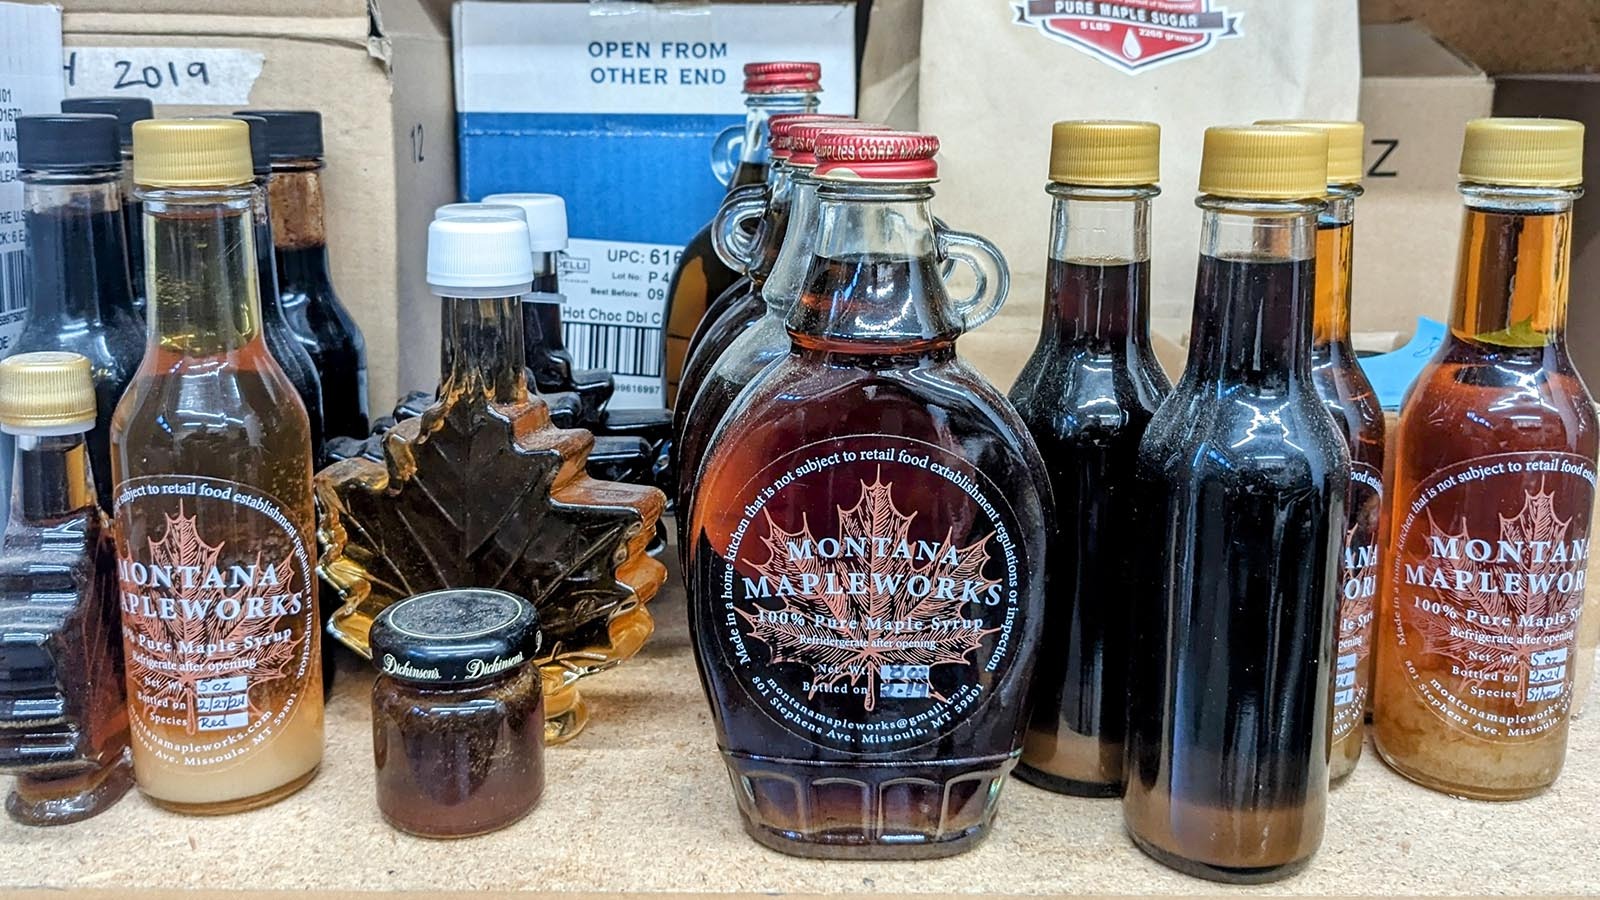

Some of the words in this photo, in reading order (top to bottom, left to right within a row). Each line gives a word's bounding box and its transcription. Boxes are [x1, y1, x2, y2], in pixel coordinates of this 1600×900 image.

[1055, 1, 1094, 14] PURE
[1100, 3, 1146, 22] MAPLE
[1151, 11, 1198, 28] SUGAR
[1090, 22, 1111, 32] LBS
[1165, 32, 1195, 43] grams
[588, 42, 650, 58] OPEN
[662, 43, 727, 58] FROM
[114, 60, 209, 90] 2019
[590, 68, 667, 84] OTHER
[679, 69, 726, 84] END
[410, 123, 425, 163] 12
[1367, 139, 1399, 177] Z
[608, 248, 645, 264] UPC:
[612, 272, 628, 281] Lot
[649, 272, 657, 284] P
[562, 308, 585, 320] Hot
[589, 309, 622, 322] Choc
[626, 311, 648, 323] Dbl
[843, 451, 857, 462] to
[861, 448, 895, 461] retail
[897, 450, 930, 469] food
[796, 453, 840, 477] subject
[774, 471, 796, 491] not
[1411, 493, 1429, 514] that
[1425, 488, 1438, 499] is
[1436, 475, 1458, 492] not
[1457, 462, 1505, 481] subject
[1508, 461, 1522, 472] to
[1525, 458, 1559, 471] retail
[1560, 459, 1584, 475] food
[762, 486, 776, 499] is
[930, 462, 1000, 523] extablishment
[119, 486, 147, 505] subject
[148, 483, 160, 495] to
[161, 482, 196, 495] retail
[199, 483, 232, 500] food
[233, 493, 298, 539] establishment
[745, 495, 767, 519] that
[724, 518, 751, 562] kitchen
[787, 537, 959, 566] MONTANA
[994, 521, 1019, 588] regulations
[721, 563, 734, 600] home
[742, 572, 1003, 607] MAPLEWORKS
[725, 602, 734, 610] a
[1008, 590, 1018, 604] or
[725, 612, 737, 626] in
[758, 610, 805, 626] 100%
[814, 614, 858, 629] Pure
[866, 615, 923, 634] Maple
[931, 617, 984, 634] Syrup
[1414, 595, 1457, 620] 100%
[1465, 609, 1511, 626] Pure
[1518, 612, 1566, 630] Maple
[139, 633, 173, 653] Pure
[178, 640, 239, 657] Maple
[244, 628, 293, 651] Syrup
[870, 638, 894, 648] after
[985, 608, 1019, 673] inspection.
[1450, 625, 1515, 645] Refrigerate
[1516, 633, 1542, 645] after
[1543, 629, 1574, 646] opening
[729, 628, 752, 665] Made
[179, 660, 205, 672] after
[208, 656, 258, 675] opening
[382, 653, 442, 680] Dickinson's
[1468, 650, 1495, 662] Net.
[1500, 654, 1521, 665] Wt.
[848, 664, 870, 676] Wt.
[1452, 665, 1498, 680] Bottled
[1503, 674, 1518, 682] on
[802, 681, 848, 694] Bottled
[853, 686, 868, 695] on
[1405, 660, 1420, 680] 801
[1418, 683, 1469, 725] Stephens
[1472, 722, 1502, 736] Ave.
[1470, 685, 1517, 699] Species
[172, 702, 187, 711] on
[752, 676, 770, 697] 801
[769, 696, 824, 734] Stephens
[826, 729, 856, 743] Ave.
[861, 727, 928, 744] Missoula,
[930, 711, 952, 729] MT
[953, 682, 985, 714] 59801
[767, 678, 969, 731] montanamapleworks@gmail.com
[150, 711, 188, 727] Species
[155, 750, 179, 764] Ave.
[252, 726, 273, 746] MT
[273, 692, 298, 727] 59801
[199, 714, 229, 729] Red
